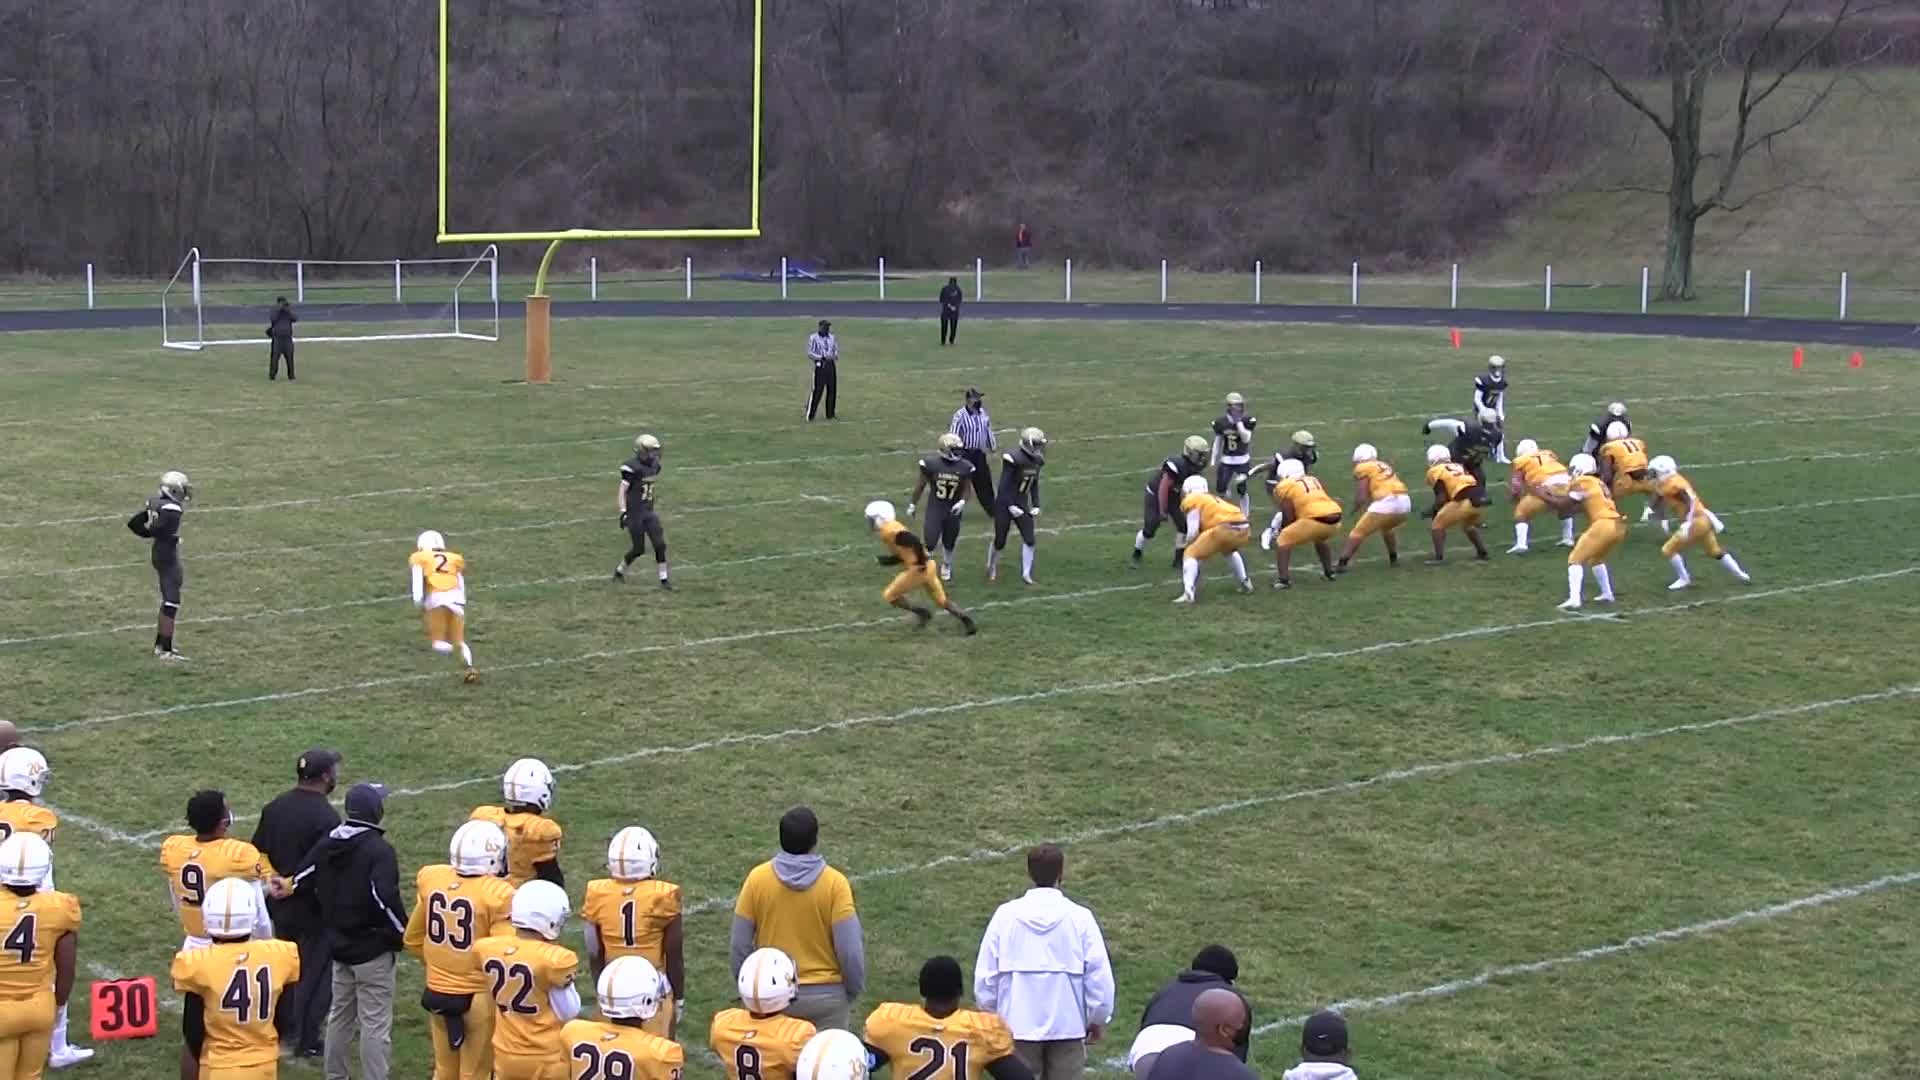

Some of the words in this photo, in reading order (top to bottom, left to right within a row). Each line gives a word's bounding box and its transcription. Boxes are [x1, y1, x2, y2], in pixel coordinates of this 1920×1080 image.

[935, 480, 960, 500] 57
[433, 552, 450, 574] 2
[179, 861, 206, 907] 9
[2, 911, 38, 966] 4
[426, 890, 474, 951] 63
[620, 899, 636, 948] 1
[99, 982, 150, 1033] 30
[220, 963, 273, 1025] 41
[483, 957, 539, 1015] 22
[734, 1042, 762, 1080] 8
[907, 1035, 970, 1080] 21
